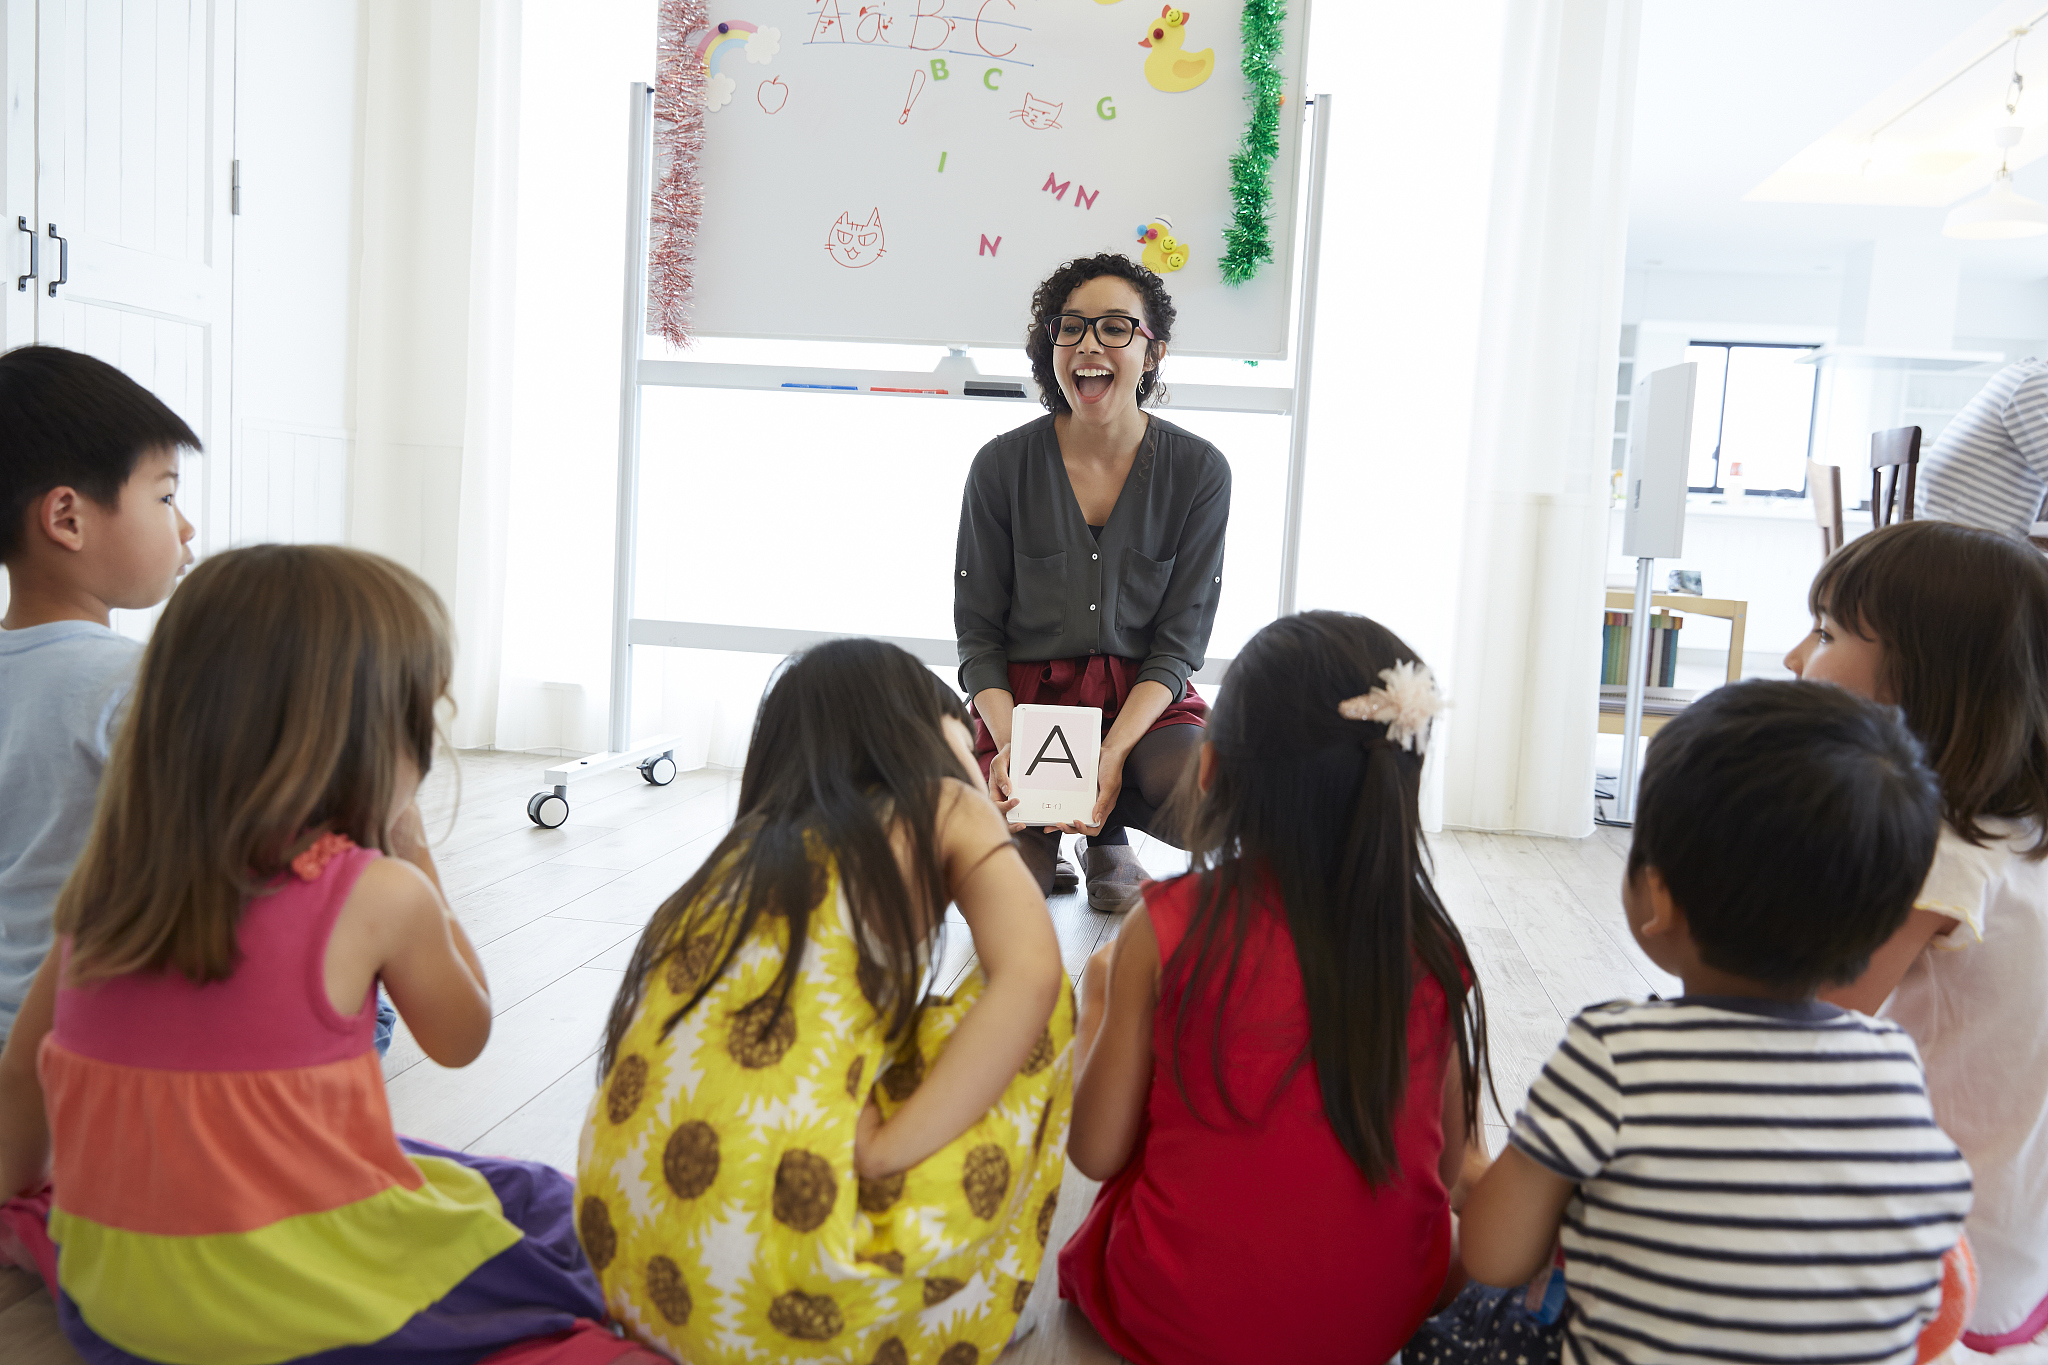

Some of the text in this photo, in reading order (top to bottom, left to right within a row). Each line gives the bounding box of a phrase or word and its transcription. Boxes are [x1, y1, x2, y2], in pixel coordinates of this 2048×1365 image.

[930, 59, 1003, 91] B C
[1096, 96, 1116, 120] G
[938, 151, 947, 173] I
[979, 233, 1002, 257] N
[1025, 725, 1083, 779] A
